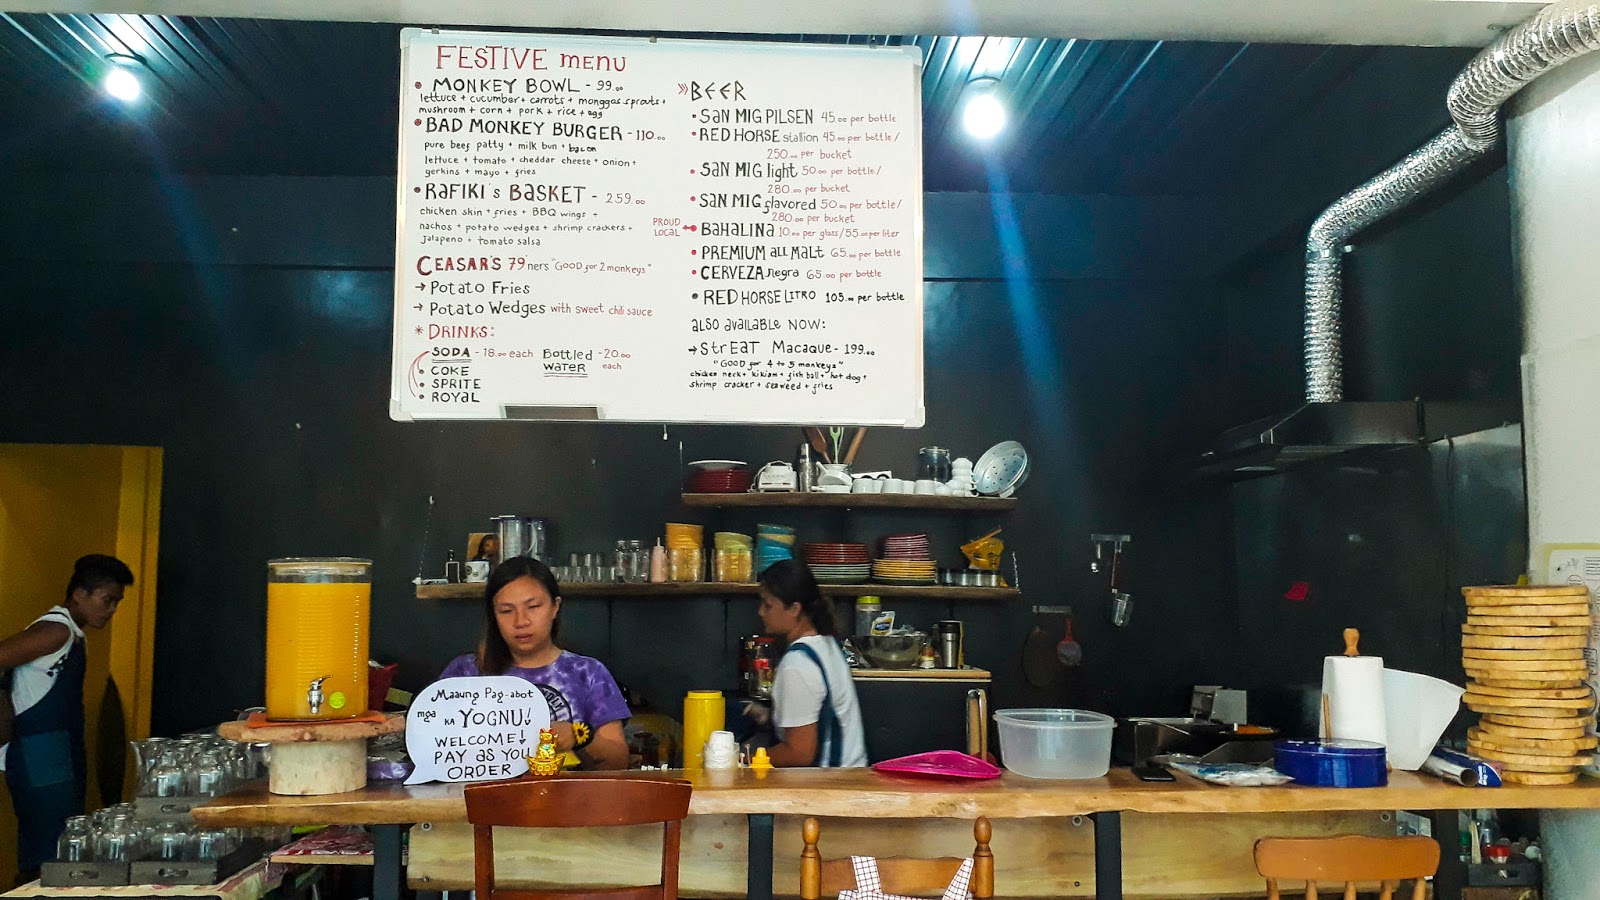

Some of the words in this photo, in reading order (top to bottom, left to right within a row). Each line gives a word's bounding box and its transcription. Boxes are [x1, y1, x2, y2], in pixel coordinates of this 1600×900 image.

[436, 45, 548, 70] FESTIVE
[432, 77, 517, 94] MONKEY
[526, 78, 580, 93] BOWL
[691, 80, 746, 101] BEER
[420, 93, 456, 103] lettuce
[530, 95, 565, 105] carrots
[623, 98, 659, 108] sprouts
[419, 106, 466, 114] mushroom
[519, 107, 543, 116] pork
[557, 107, 576, 116] rice
[735, 108, 762, 123] MIG
[766, 109, 813, 124] PILSEN
[851, 117, 864, 126] per
[868, 114, 896, 122] bottle
[425, 117, 463, 133] BAD
[469, 119, 545, 135] MONKEY
[552, 122, 623, 141] BURGER
[699, 127, 731, 142] RED
[734, 128, 780, 143] HORSE
[783, 132, 818, 143] stallion
[847, 136, 861, 144] per
[425, 142, 445, 151] pure
[450, 140, 470, 151] beef
[477, 140, 503, 152] patty
[518, 141, 537, 150] milk
[542, 142, 557, 150] bun
[425, 155, 459, 164] lettuce
[473, 156, 506, 165] tomato
[561, 156, 591, 165] cheese
[602, 158, 630, 167] onion
[801, 151, 814, 159] per
[820, 149, 852, 159] bucket
[425, 167, 460, 178] gerkins
[475, 170, 500, 178] mayo
[515, 168, 536, 178] fries
[735, 162, 762, 178] MIG
[767, 163, 798, 182] light
[831, 170, 843, 178] per
[805, 187, 817, 195] per
[821, 184, 850, 192] bucket
[731, 194, 761, 208] MIG
[761, 197, 816, 214] flavored
[850, 203, 862, 212] per
[420, 206, 457, 215] chicken
[462, 207, 482, 216] skin
[492, 208, 517, 219] fries
[533, 207, 556, 216] BBQ
[560, 211, 586, 220] wings
[807, 216, 820, 224] per
[824, 214, 855, 223] bucket
[420, 222, 452, 231] nachos
[466, 224, 499, 233] potato
[503, 224, 540, 234] wedges
[552, 224, 583, 233] shrimp
[653, 218, 680, 226] PROUD
[478, 236, 514, 245] tomato
[517, 237, 540, 246] salsa
[803, 231, 816, 239] per
[882, 229, 900, 237] liter
[702, 245, 766, 260] PREMIUM
[859, 253, 871, 261] per
[875, 249, 901, 257] bottle
[416, 255, 501, 276] CEASAR'S
[584, 264, 597, 273] for
[701, 265, 765, 280] CERVEZA
[764, 268, 799, 281] negra
[840, 272, 852, 283] per
[856, 269, 882, 277] bottle
[430, 280, 485, 295] Potato
[492, 281, 530, 294] Fries
[704, 289, 738, 305] RED
[742, 290, 781, 305] HORSE
[785, 289, 816, 303] LITRO
[858, 295, 872, 304] per
[876, 292, 905, 302] bottle
[430, 302, 484, 316] Potato
[488, 300, 546, 318] Wedges
[551, 303, 571, 313] with
[575, 303, 604, 314] sweet
[627, 308, 652, 316] sauce
[431, 347, 470, 357] SODA
[509, 349, 533, 358] each
[772, 340, 832, 354] Macaque
[543, 349, 592, 361] Bottled
[431, 366, 469, 376] COKE
[749, 361, 761, 371] for
[431, 379, 481, 389] SPRITE
[846, 373, 861, 383] dog
[689, 380, 717, 390] shrimp
[765, 381, 801, 390] seaweed
[812, 382, 833, 395] fries
[432, 690, 479, 704] Maaung
[485, 687, 534, 703] Pag-abot
[418, 711, 436, 722] mga
[435, 751, 467, 764] PAY
[477, 749, 494, 761] as
[503, 748, 530, 760] YOU
[448, 764, 511, 779] ORDER
